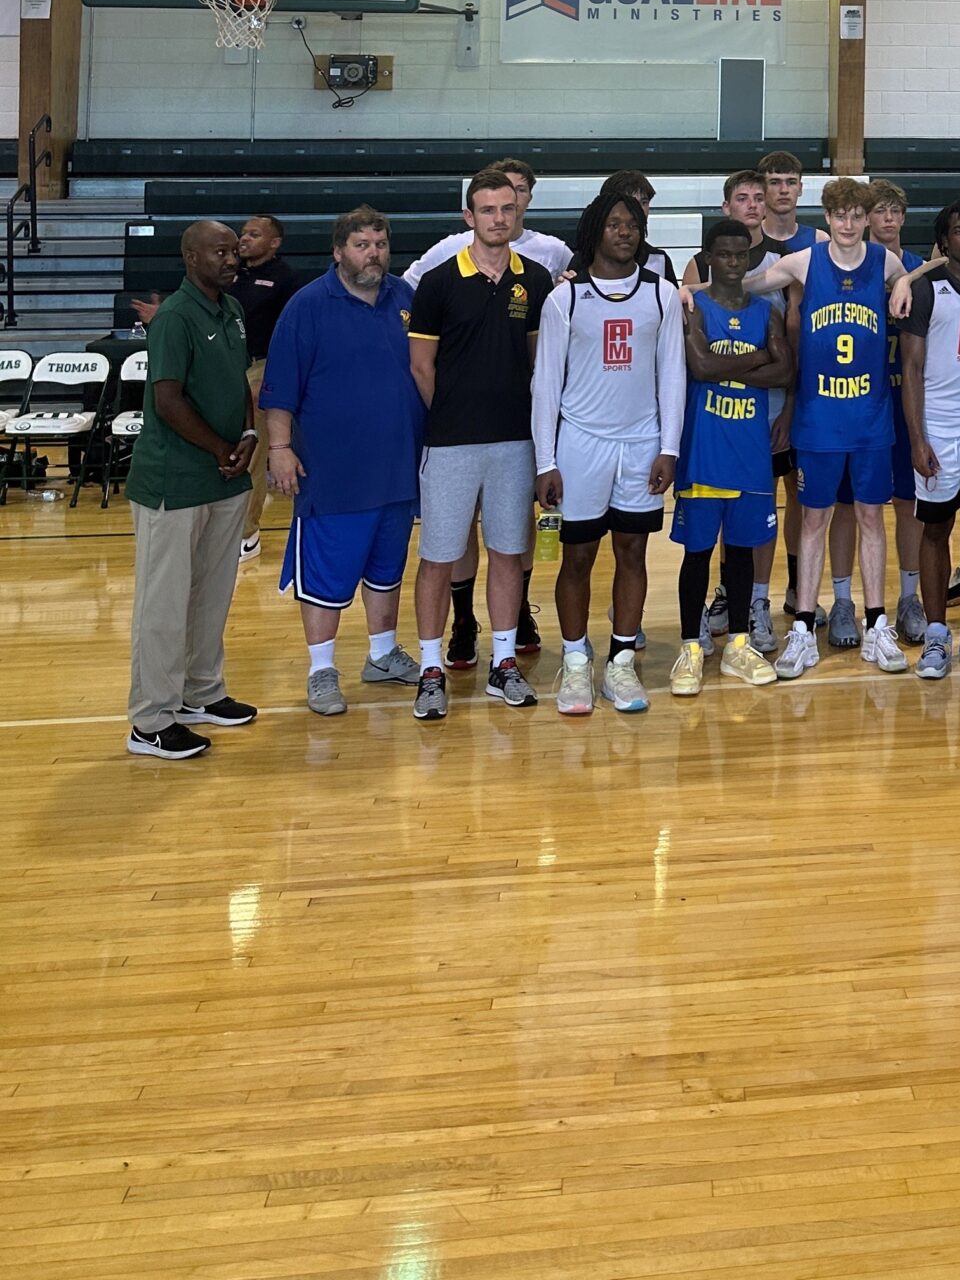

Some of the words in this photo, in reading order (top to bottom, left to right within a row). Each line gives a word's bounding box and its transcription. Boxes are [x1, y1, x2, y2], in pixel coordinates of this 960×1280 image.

[587, 7, 783, 22] MINISTRIES
[811, 302, 843, 333] YOUTH
[844, 302, 878, 335] SPORTS
[836, 334, 854, 364] 9
[48, 362, 98, 373] THOMAS
[602, 364, 632, 372] SPORTS
[818, 373, 870, 399] LIONS
[705, 389, 756, 420] LIONS
